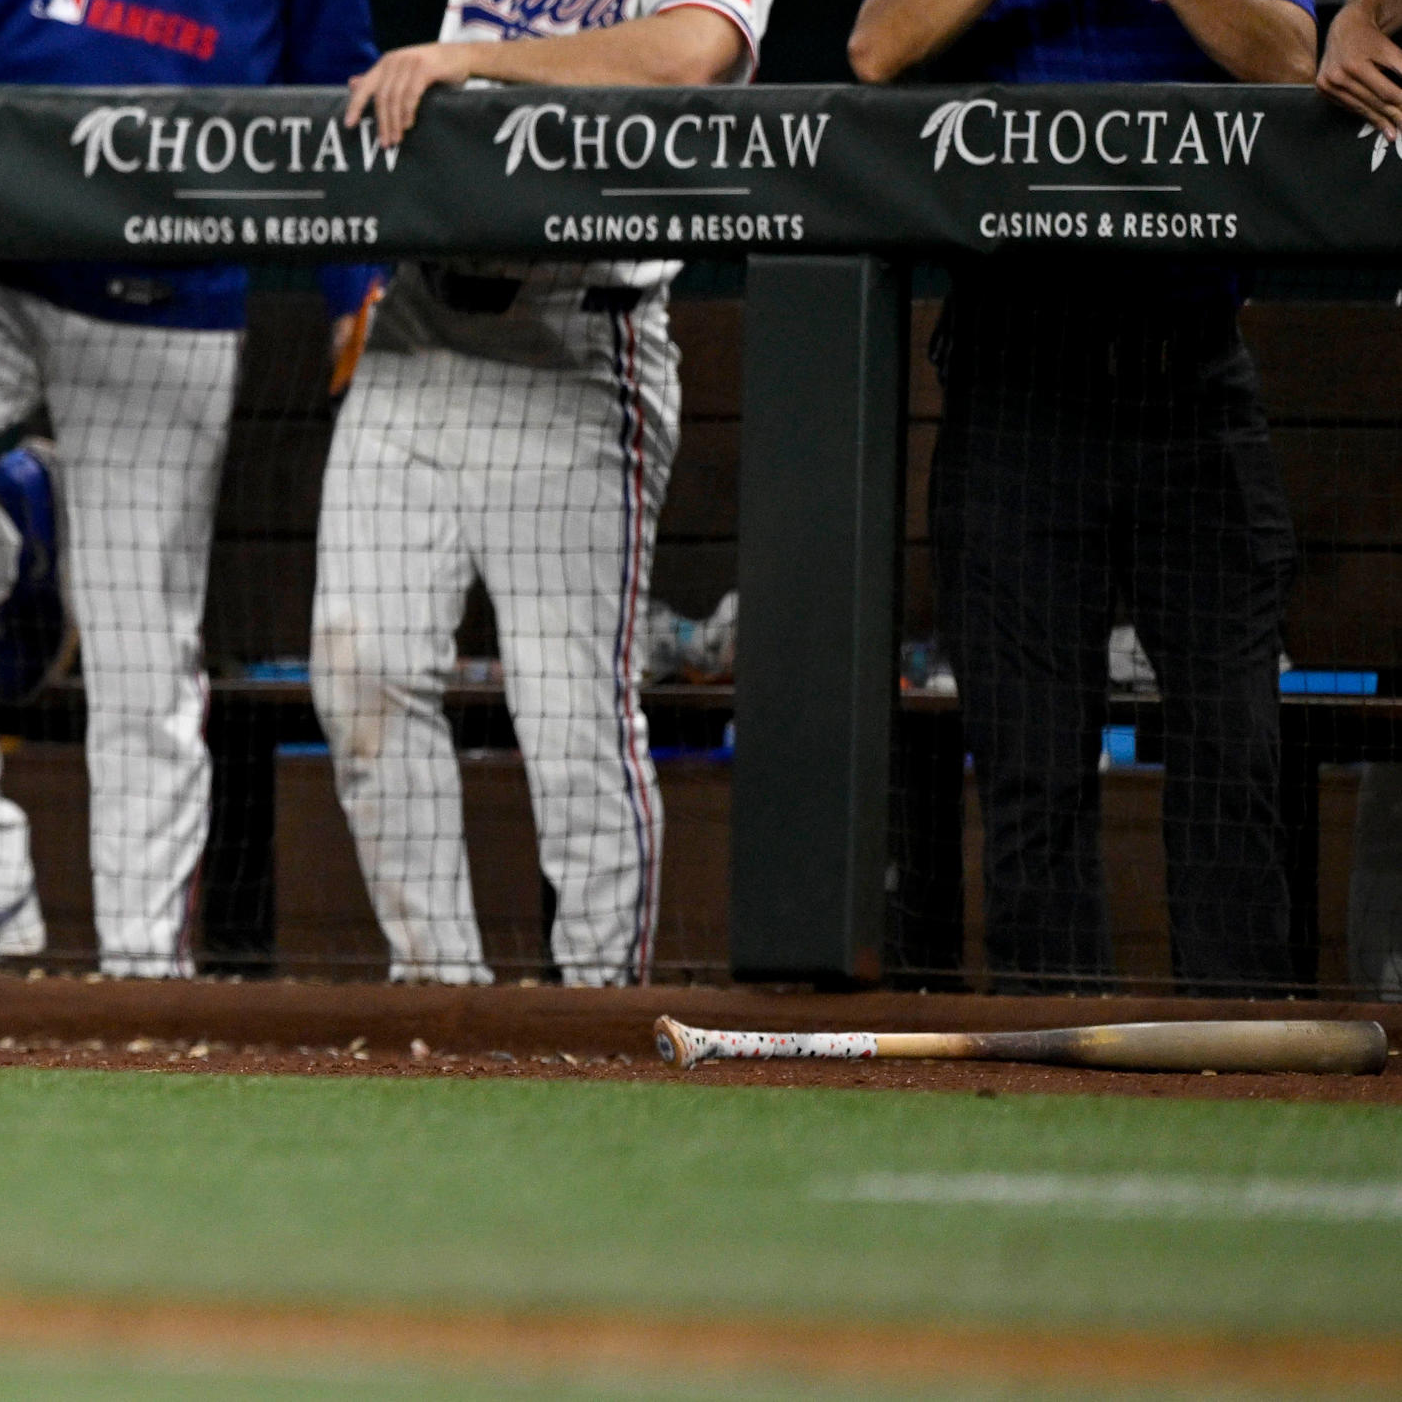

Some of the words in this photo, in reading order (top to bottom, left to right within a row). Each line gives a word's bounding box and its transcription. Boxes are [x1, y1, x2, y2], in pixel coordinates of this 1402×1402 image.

[100, 105, 400, 174] CHOCTAW
[525, 102, 831, 172] CHOCTAW
[952, 98, 1265, 166] CHOCTAW
[124, 216, 235, 245] CASINOS
[241, 217, 258, 244] &
[264, 216, 379, 245] RESORTS
[544, 213, 659, 243] CASINOS
[667, 215, 684, 241] &
[691, 212, 805, 241] RESORTS
[979, 211, 1090, 239] CASINOS
[1097, 212, 1114, 238] &
[1121, 211, 1239, 239] RESORTS
